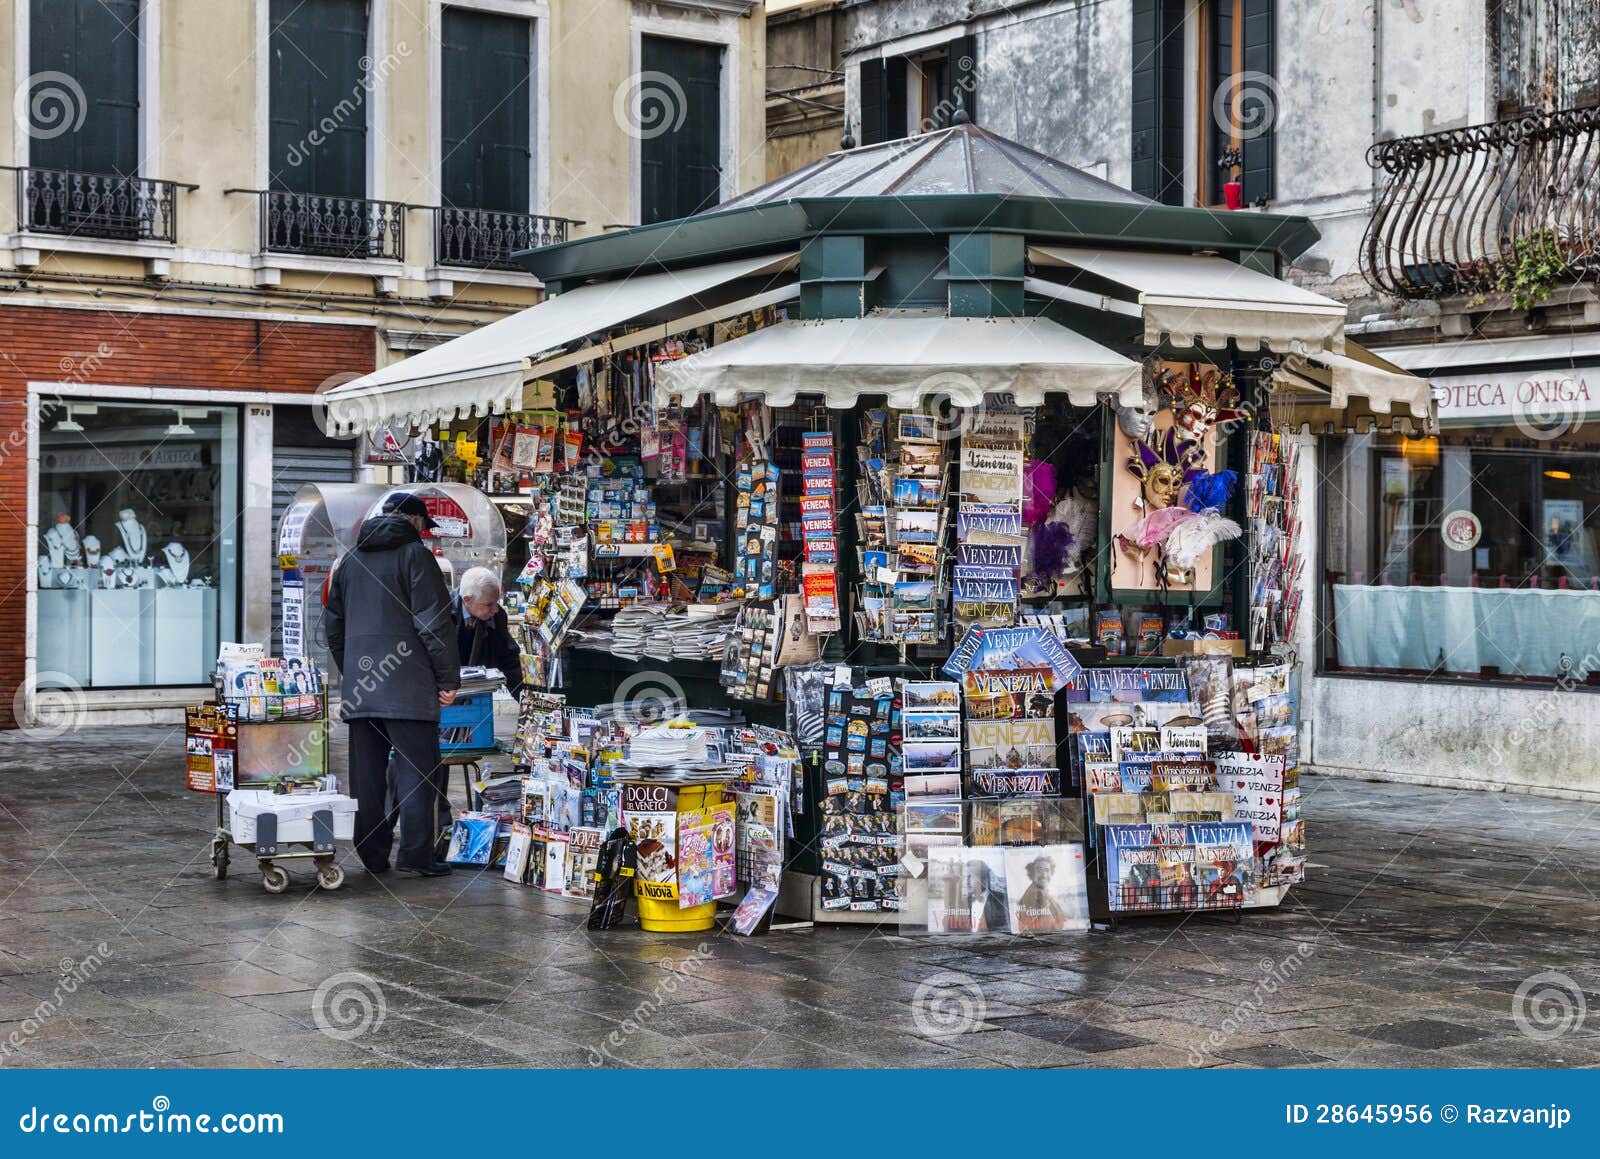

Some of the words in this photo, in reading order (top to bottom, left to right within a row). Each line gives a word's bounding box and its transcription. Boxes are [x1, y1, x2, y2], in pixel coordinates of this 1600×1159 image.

[1516, 378, 1592, 404] ONIGA
[805, 478, 832, 488] VENICE
[960, 513, 1018, 534] VENEZIA
[808, 541, 835, 551] VENEZIA
[961, 545, 1019, 565] VENEZIA
[956, 577, 1017, 599] VENEZIA
[956, 602, 1012, 617] VENEZIA
[946, 628, 982, 675] VENEZIA
[1038, 629, 1078, 680] VENEZIA
[973, 671, 1048, 694] VENEZIA
[1143, 669, 1188, 690] VENEZIA
[970, 722, 1052, 746] VENEZIA
[1156, 764, 1214, 786] VENEZIA
[1220, 765, 1264, 776] VENEZIA
[980, 772, 1054, 793] VENEZIA
[1248, 782, 1281, 792] VENEZ
[628, 787, 668, 802] DOLCI
[635, 800, 667, 811] VENETO
[1234, 809, 1277, 821] VENEZIA
[570, 830, 597, 848] DOVE
[1190, 824, 1249, 846] VENEZIA
[1199, 845, 1239, 862] VENEZIA
[645, 883, 674, 899] Nuova
